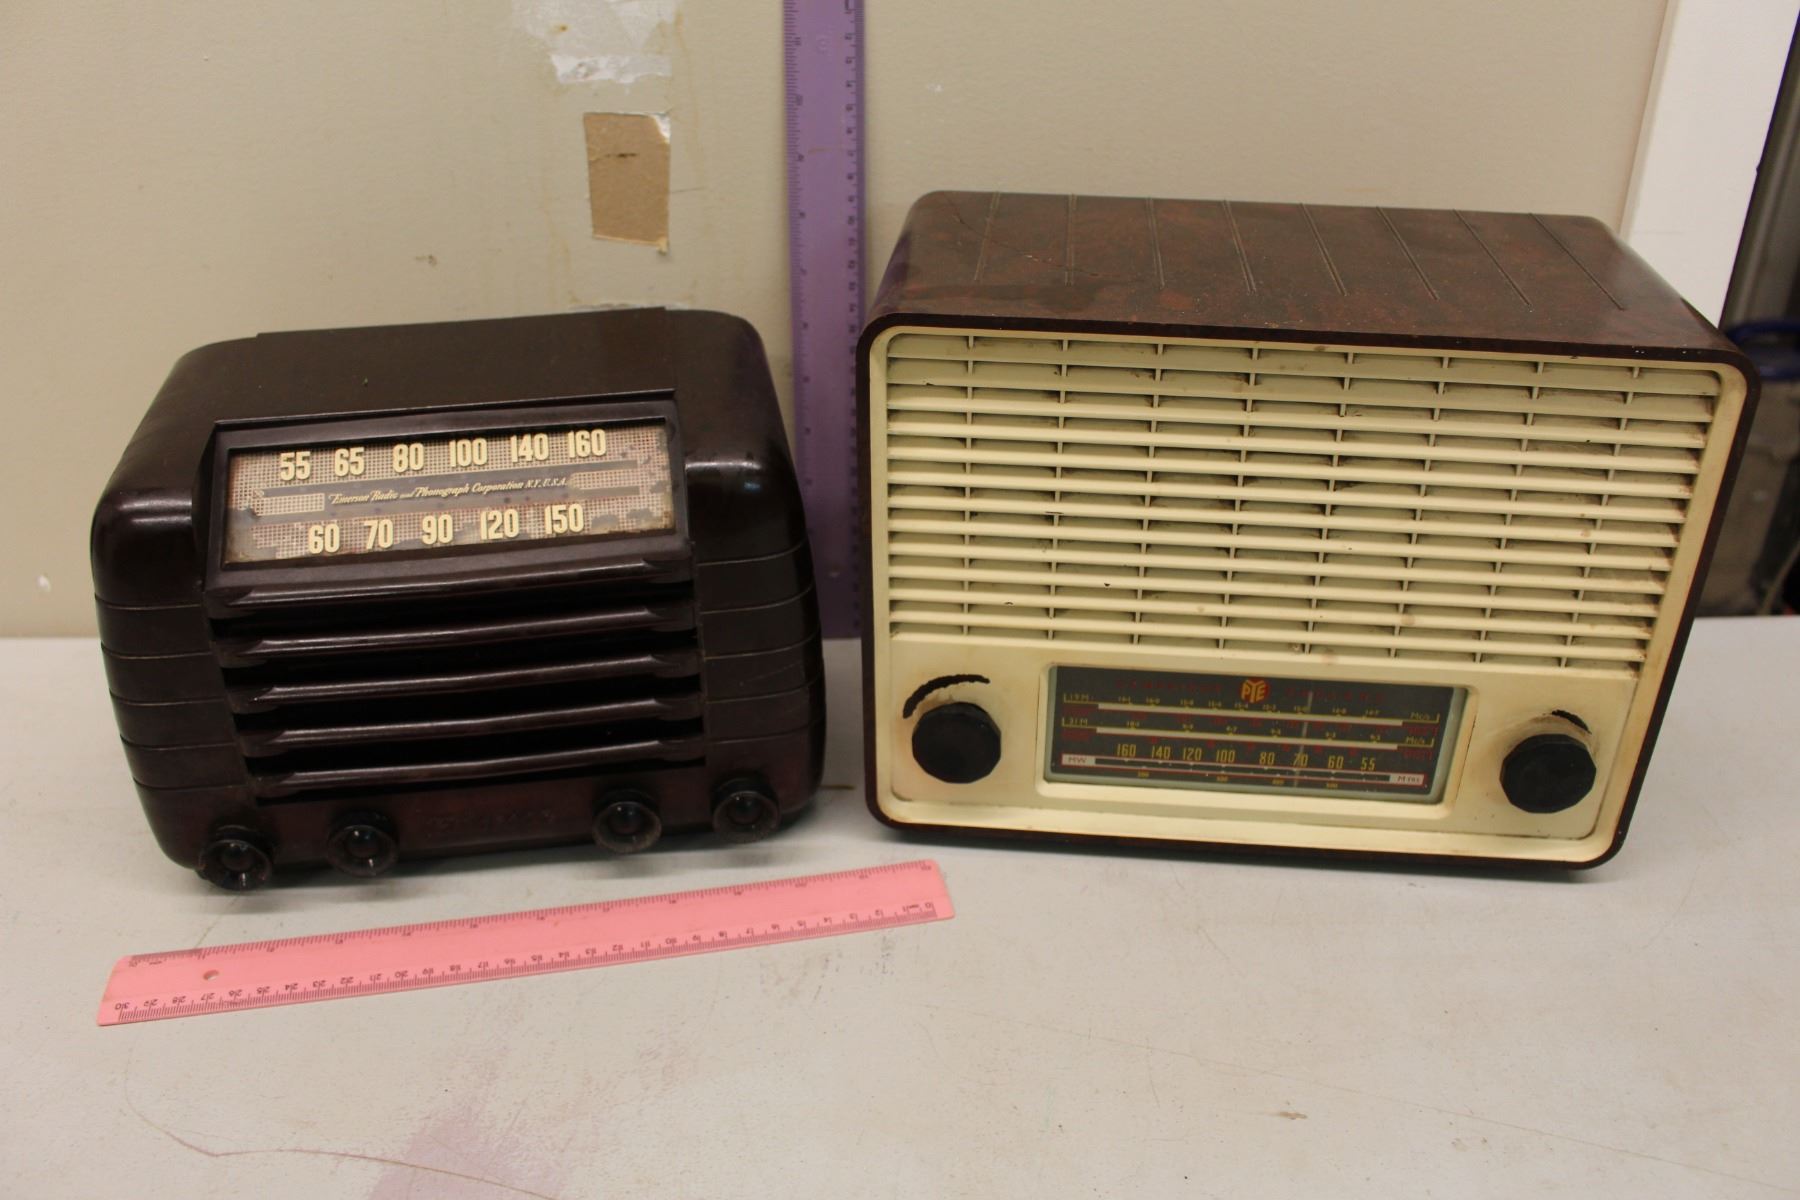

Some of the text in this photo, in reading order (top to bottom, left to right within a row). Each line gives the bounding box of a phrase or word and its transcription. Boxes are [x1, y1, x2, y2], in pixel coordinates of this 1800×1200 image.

[280, 429, 607, 480] 55 65 80 100 140 160
[369, 489, 399, 502] Radio
[413, 483, 470, 498] Phonograph
[471, 480, 524, 495] Corporation
[308, 503, 584, 554] 60 70 90 120 150
[1241, 679, 1266, 703] PYE
[1117, 743, 1376, 771] 160 140 120 100 80 70 60 55
[394, 970, 409, 979] 20
[256, 986, 270, 995] 25
[285, 982, 299, 991] 24
[200, 992, 215, 1001] 27
[228, 988, 243, 997] 26
[115, 1002, 130, 1010] 30
